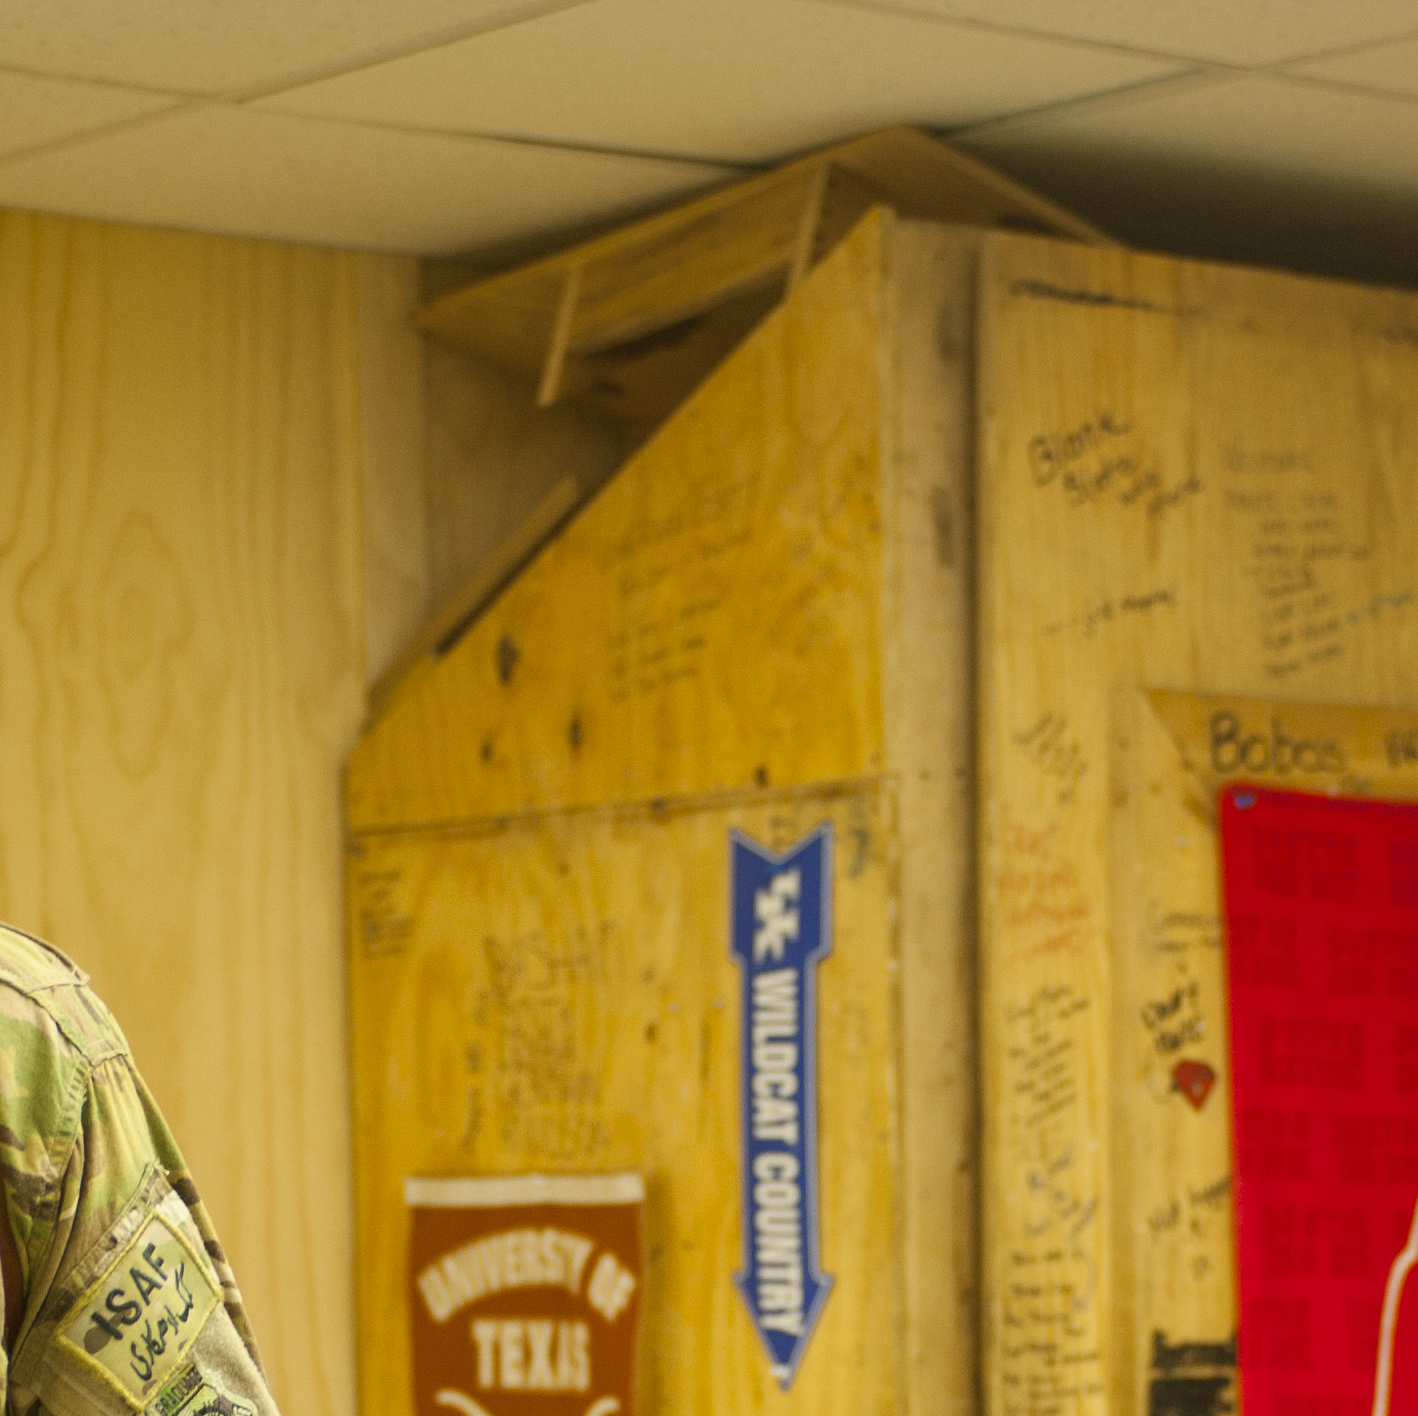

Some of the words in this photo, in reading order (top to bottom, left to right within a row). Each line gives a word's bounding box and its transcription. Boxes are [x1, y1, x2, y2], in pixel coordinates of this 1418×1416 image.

[752, 966, 800, 1146] WILDCAT
[91, 1243, 169, 1341] ISAF
[417, 1227, 594, 1324] UNIVERSITY
[587, 1252, 636, 1324] OF
[753, 1151, 807, 1336] COUNTRY
[471, 1317, 592, 1393] TEXAS
